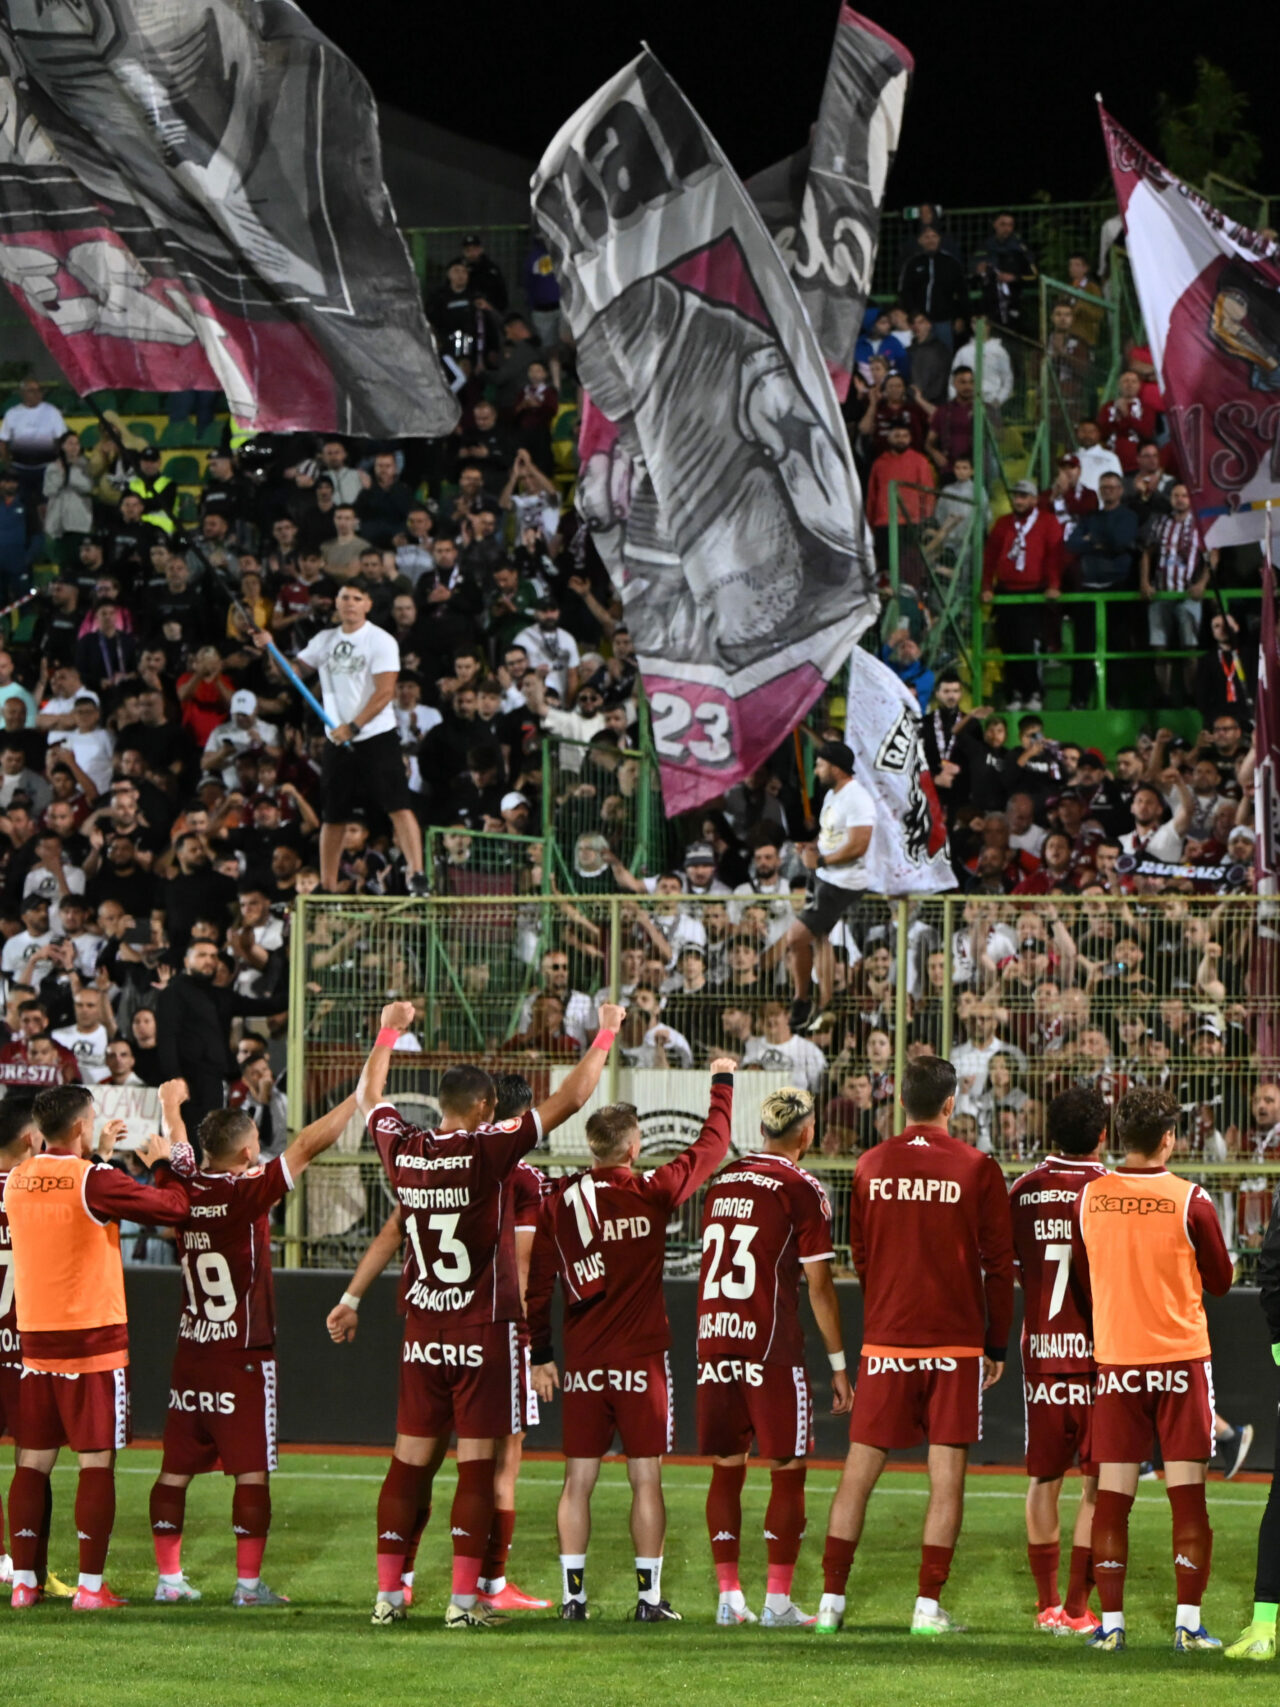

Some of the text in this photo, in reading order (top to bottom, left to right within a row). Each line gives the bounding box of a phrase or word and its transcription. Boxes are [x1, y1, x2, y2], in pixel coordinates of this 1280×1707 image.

[650, 693, 733, 767] 23
[869, 1178, 961, 1204] FC RAPID
[711, 1197, 754, 1219] MANEA
[1089, 1194, 1176, 1215] Kappa
[602, 1216, 651, 1242] APID
[405, 1213, 471, 1283] 13
[702, 1223, 759, 1301] 23
[181, 1252, 237, 1321] 19
[1044, 1243, 1072, 1321] 7
[403, 1341, 483, 1367] DACRIS
[564, 1370, 648, 1393] DACRIS
[1097, 1370, 1189, 1396] DACRIS
[168, 1389, 236, 1415] DACRIS
